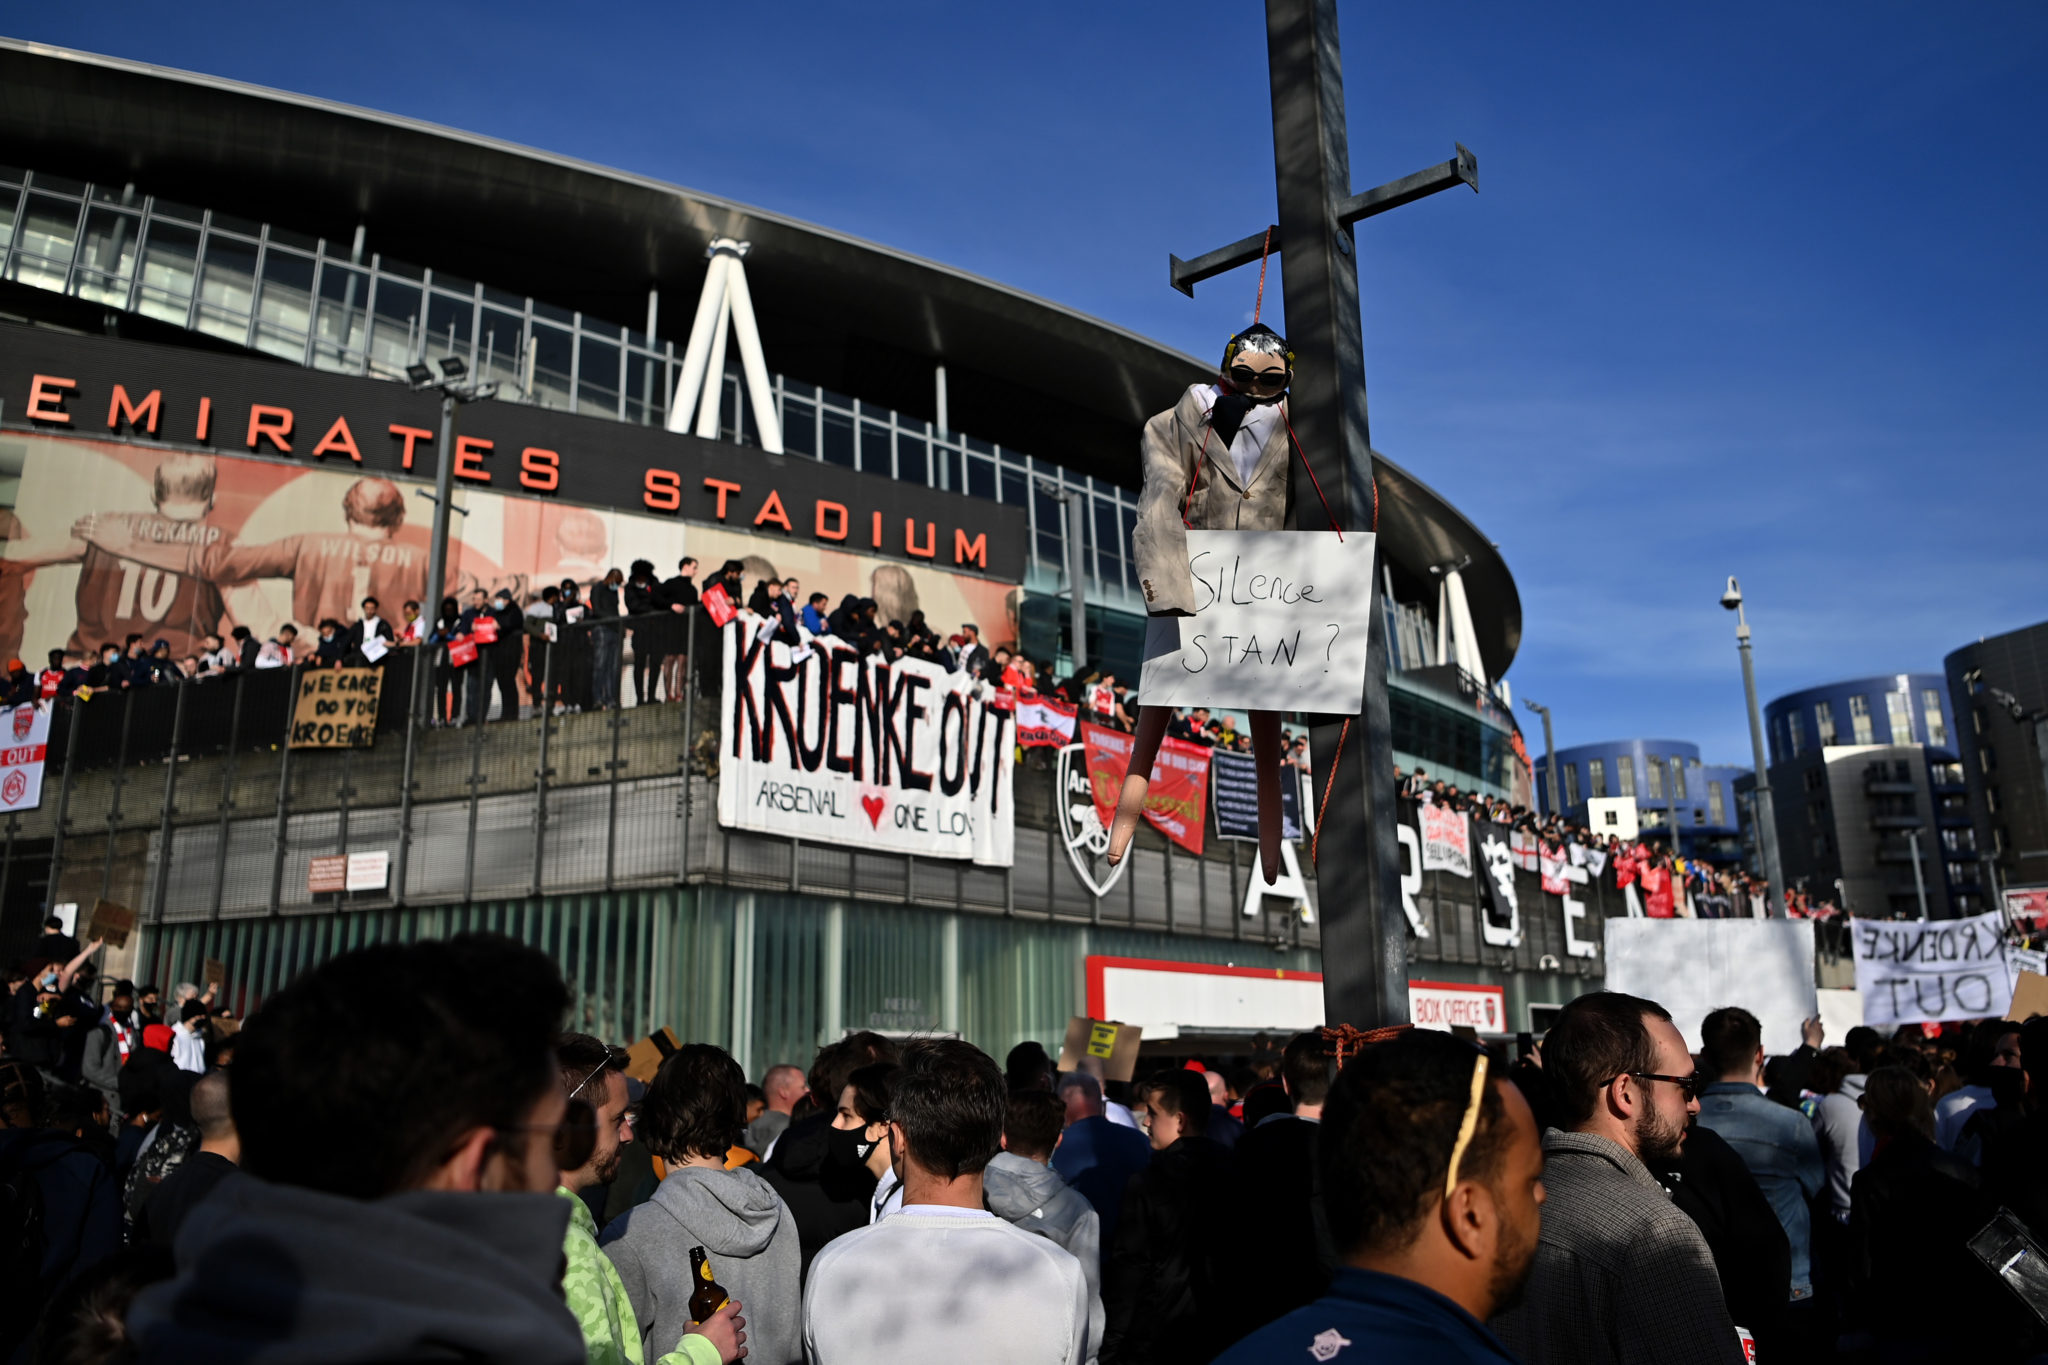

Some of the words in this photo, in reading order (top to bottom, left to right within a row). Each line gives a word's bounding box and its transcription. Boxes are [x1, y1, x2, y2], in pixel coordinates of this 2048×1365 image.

[27, 374, 560, 491] EMIRATES
[644, 468, 987, 569] STADIUM
[321, 538, 412, 568] WILSON
[115, 559, 179, 622] 10
[1182, 630, 1301, 674] STAN
[303, 675, 334, 698] WE
[337, 674, 378, 695] CARE
[316, 699, 339, 716] DO
[733, 619, 933, 792] KROENKE
[939, 688, 1011, 818] OUT
[7, 746, 37, 766] OUT
[756, 779, 845, 819] ARSENAL
[894, 803, 928, 832] ONE
[937, 811, 975, 838] LOV
[1416, 997, 1442, 1023] BOX
[1443, 998, 1481, 1025] OFFICE
